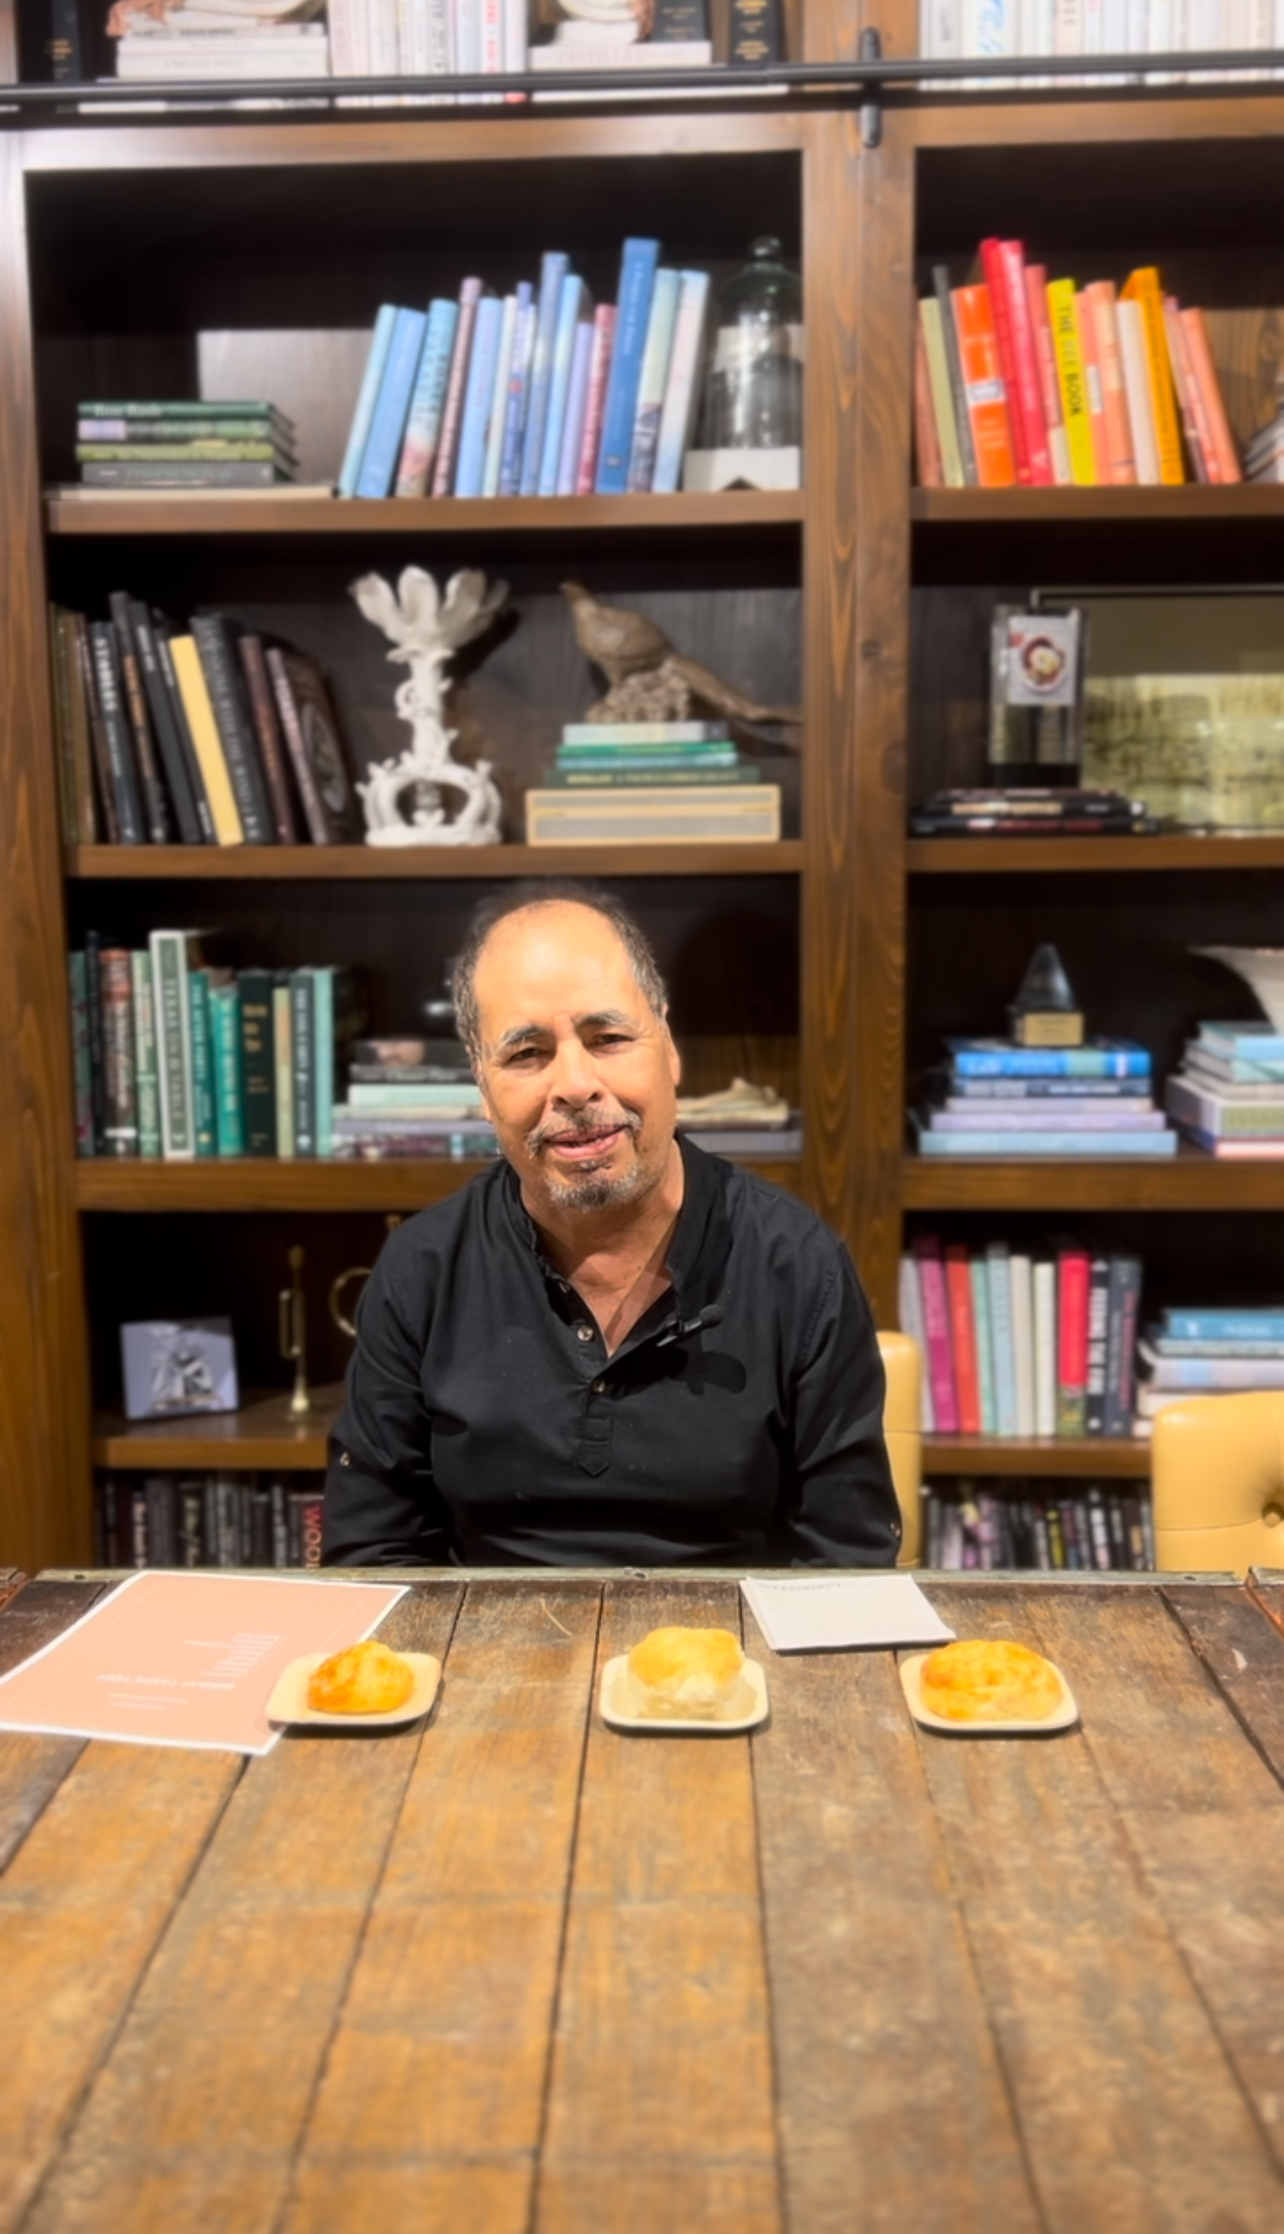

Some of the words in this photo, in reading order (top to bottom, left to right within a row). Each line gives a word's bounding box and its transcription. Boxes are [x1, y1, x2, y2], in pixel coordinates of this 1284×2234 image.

[1058, 305, 1074, 333] THE
[1065, 374, 1082, 417] BOOK
[164, 978, 178, 1029] TEXAS
[191, 983, 204, 1005] THE
[167, 1032, 180, 1054] ON
[193, 1009, 207, 1043] AFTER
[196, 1046, 208, 1080] PARTY
[171, 1075, 184, 1119] TABLE
[303, 1505, 322, 1568] WOO
